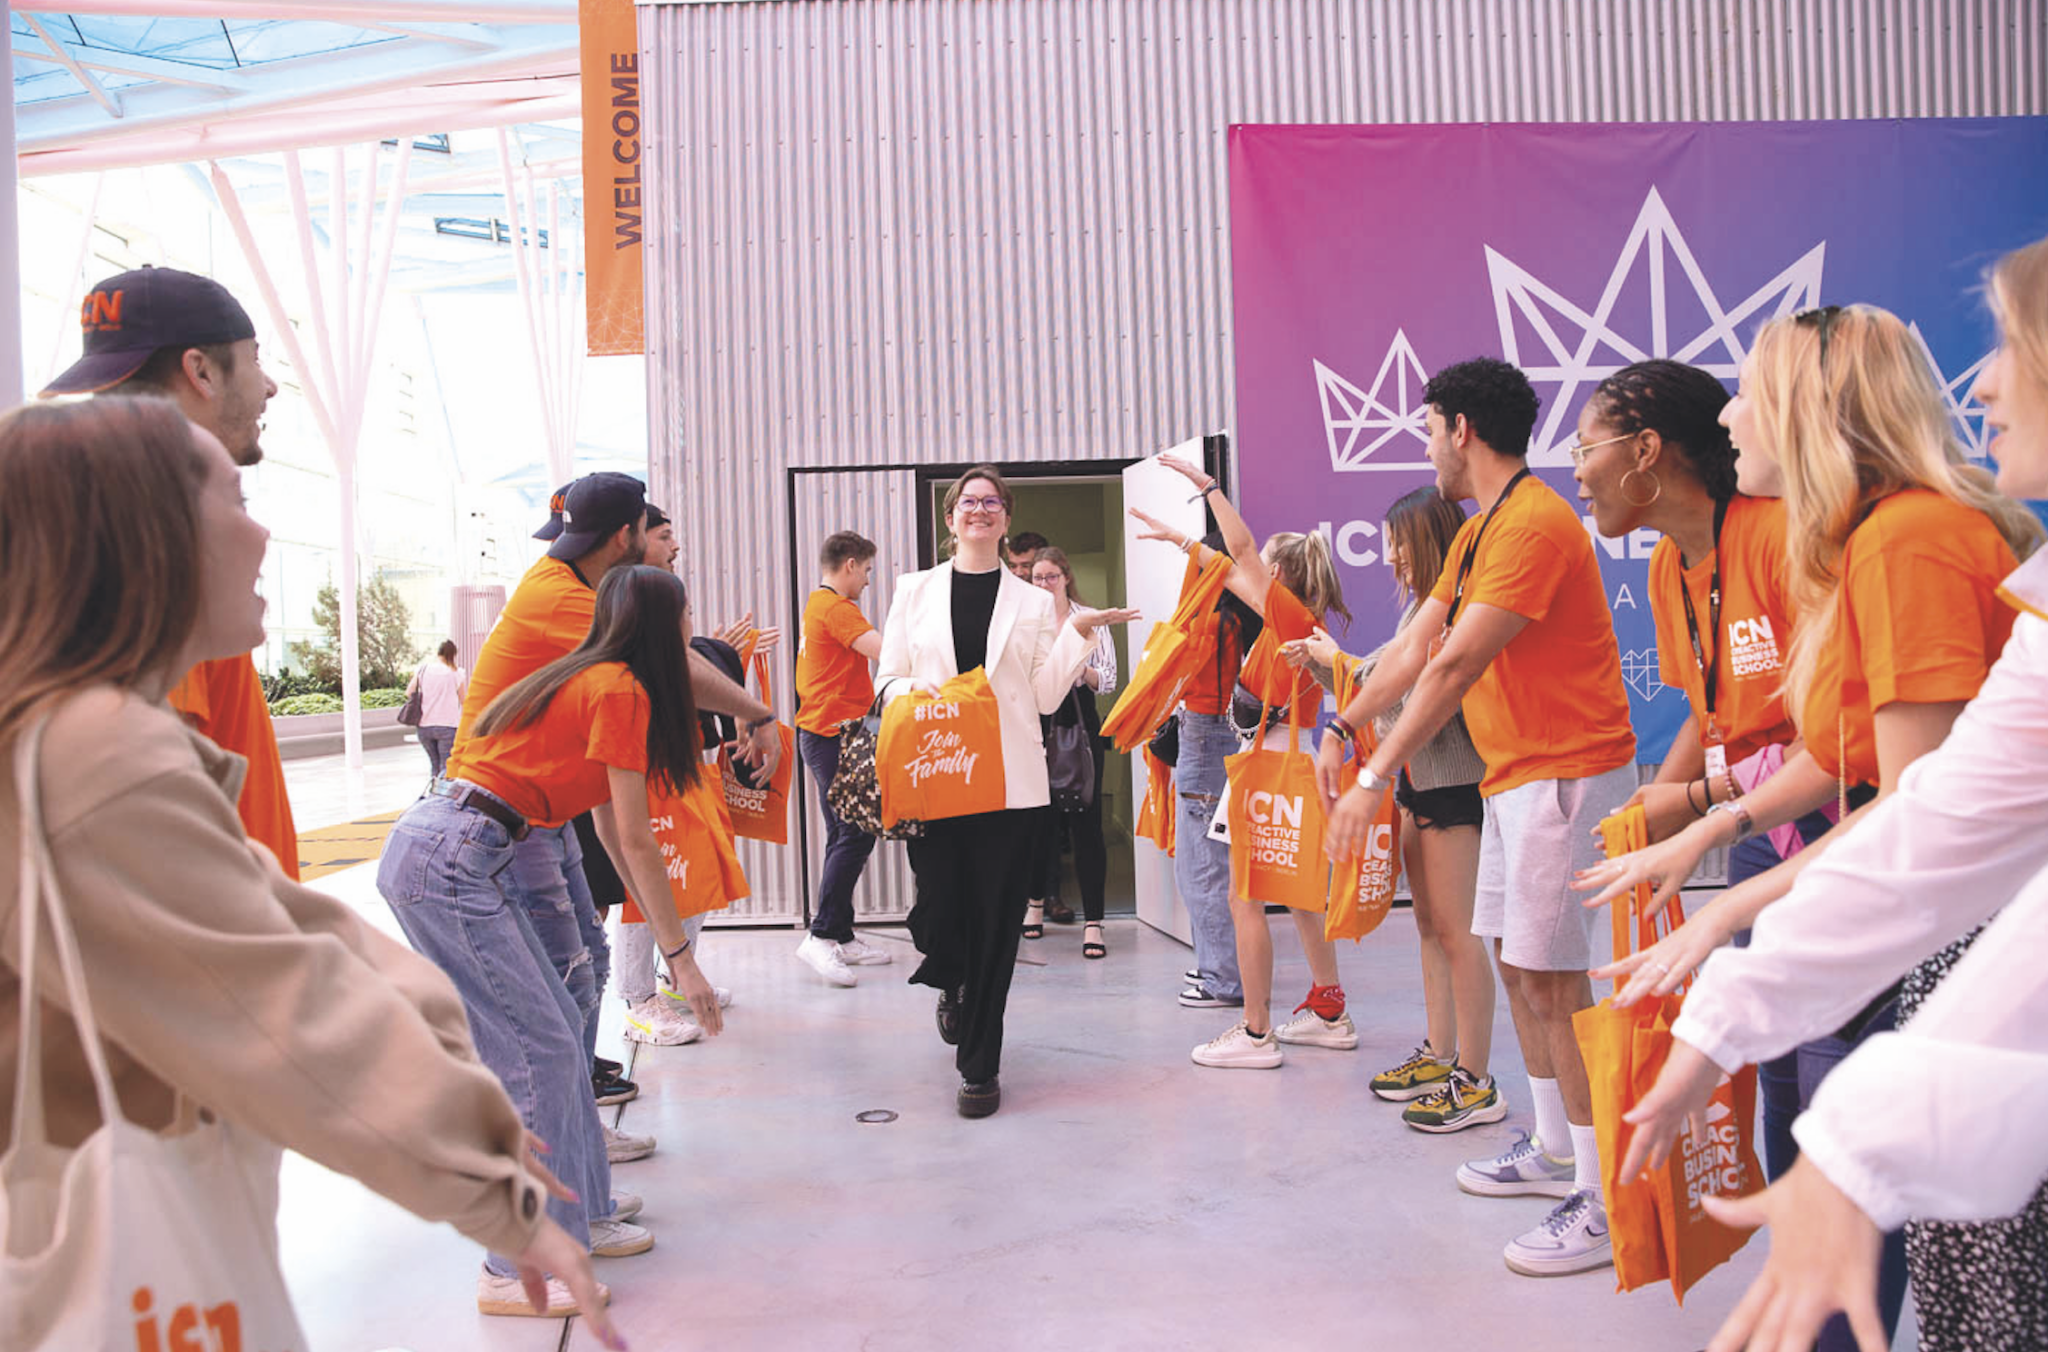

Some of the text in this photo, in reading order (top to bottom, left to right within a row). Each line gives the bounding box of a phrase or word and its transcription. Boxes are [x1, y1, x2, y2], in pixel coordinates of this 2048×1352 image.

[611, 53, 642, 250] WELCOME
[81, 290, 123, 325] CN
[1318, 520, 1396, 567] IC
[1728, 615, 1774, 648] ICN
[1733, 658, 1783, 676] SCHOOL
[915, 702, 960, 721] #ICN
[917, 730, 962, 755] Join
[904, 746, 979, 788] Family
[649, 815, 674, 832] CN
[1243, 789, 1304, 828] ICN
[1251, 835, 1299, 853] SINESS
[1251, 848, 1298, 868] HOOL
[1364, 824, 1392, 860] IC
